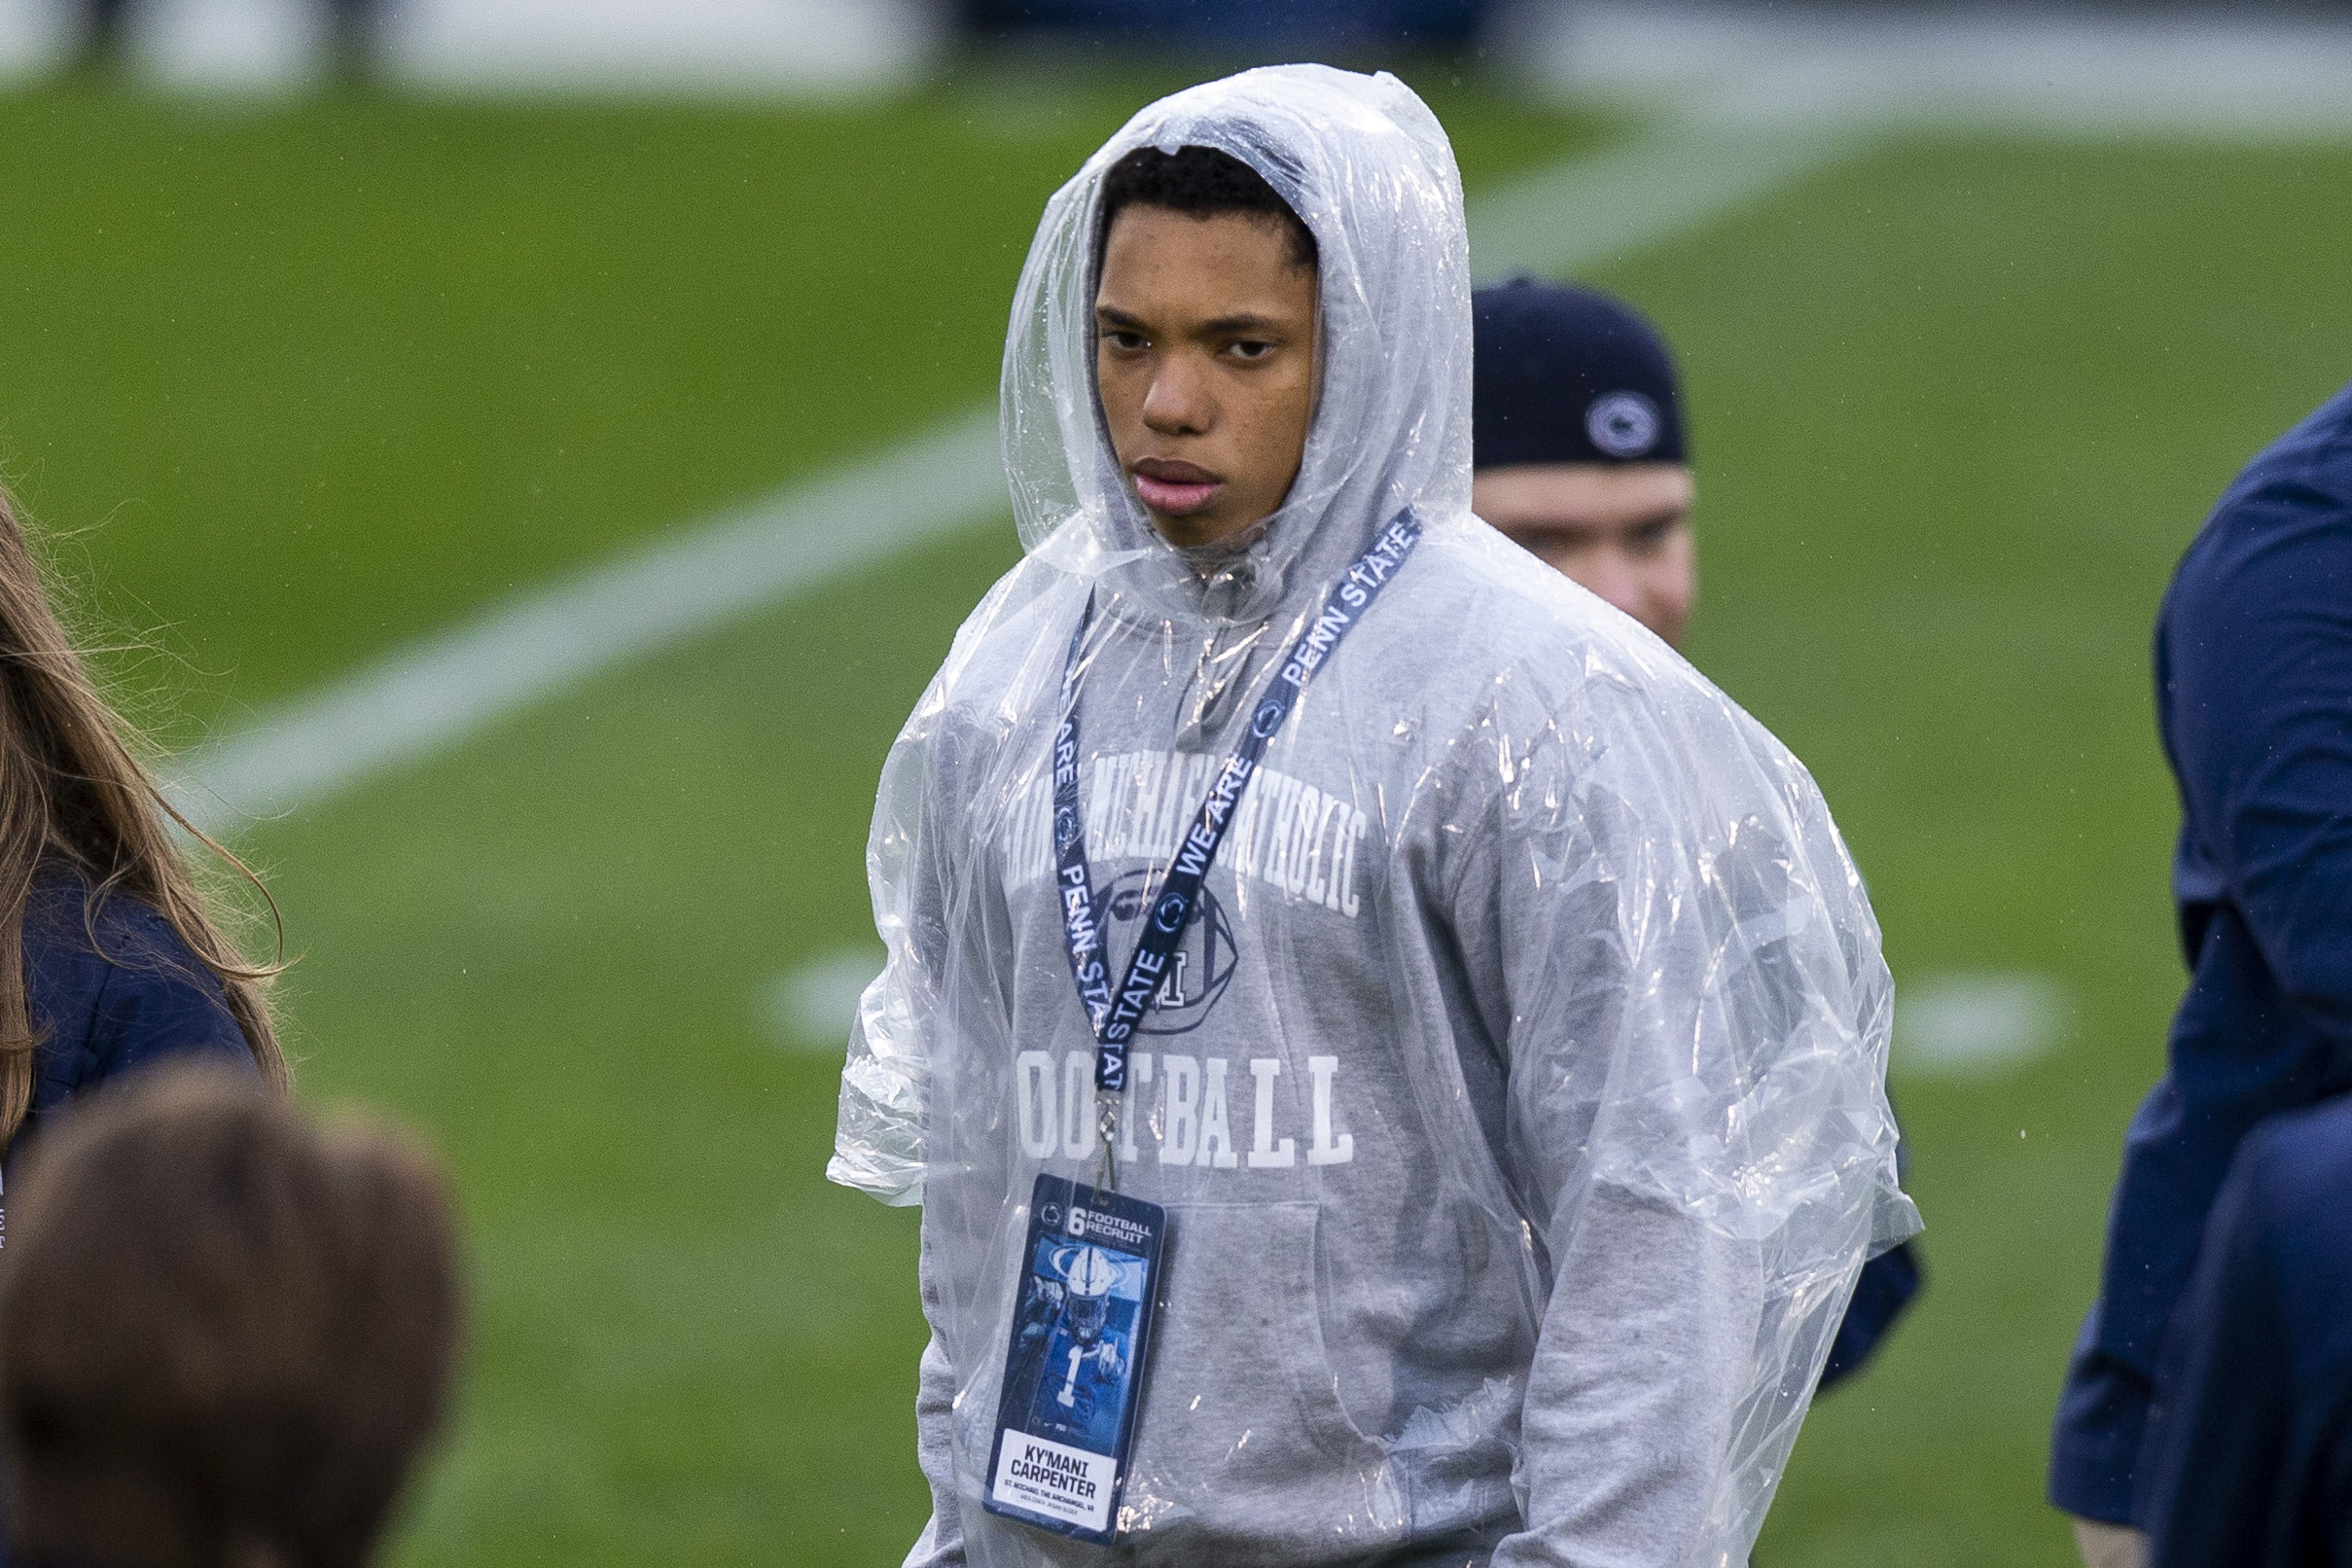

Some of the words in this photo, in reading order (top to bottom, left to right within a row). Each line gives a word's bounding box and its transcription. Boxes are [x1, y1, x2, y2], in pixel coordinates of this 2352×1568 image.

[1281, 605, 1350, 687] PENN
[1340, 521, 1415, 607] STATE
[1056, 723, 1074, 788] ARE
[1176, 822, 1218, 875] WE
[1205, 753, 1253, 825] ARE
[1061, 864, 1098, 953] PENN
[1107, 948, 1165, 1040] STATE
[1016, 1051, 1353, 1168] OOTBALL
[1068, 1206, 1087, 1236] 6
[1086, 1221, 1144, 1244] RECRUIT
[1087, 1210, 1152, 1236] FOOTBALL
[1011, 1459, 1096, 1499] CARPENTER
[1024, 1443, 1089, 1478] KY'MANI
